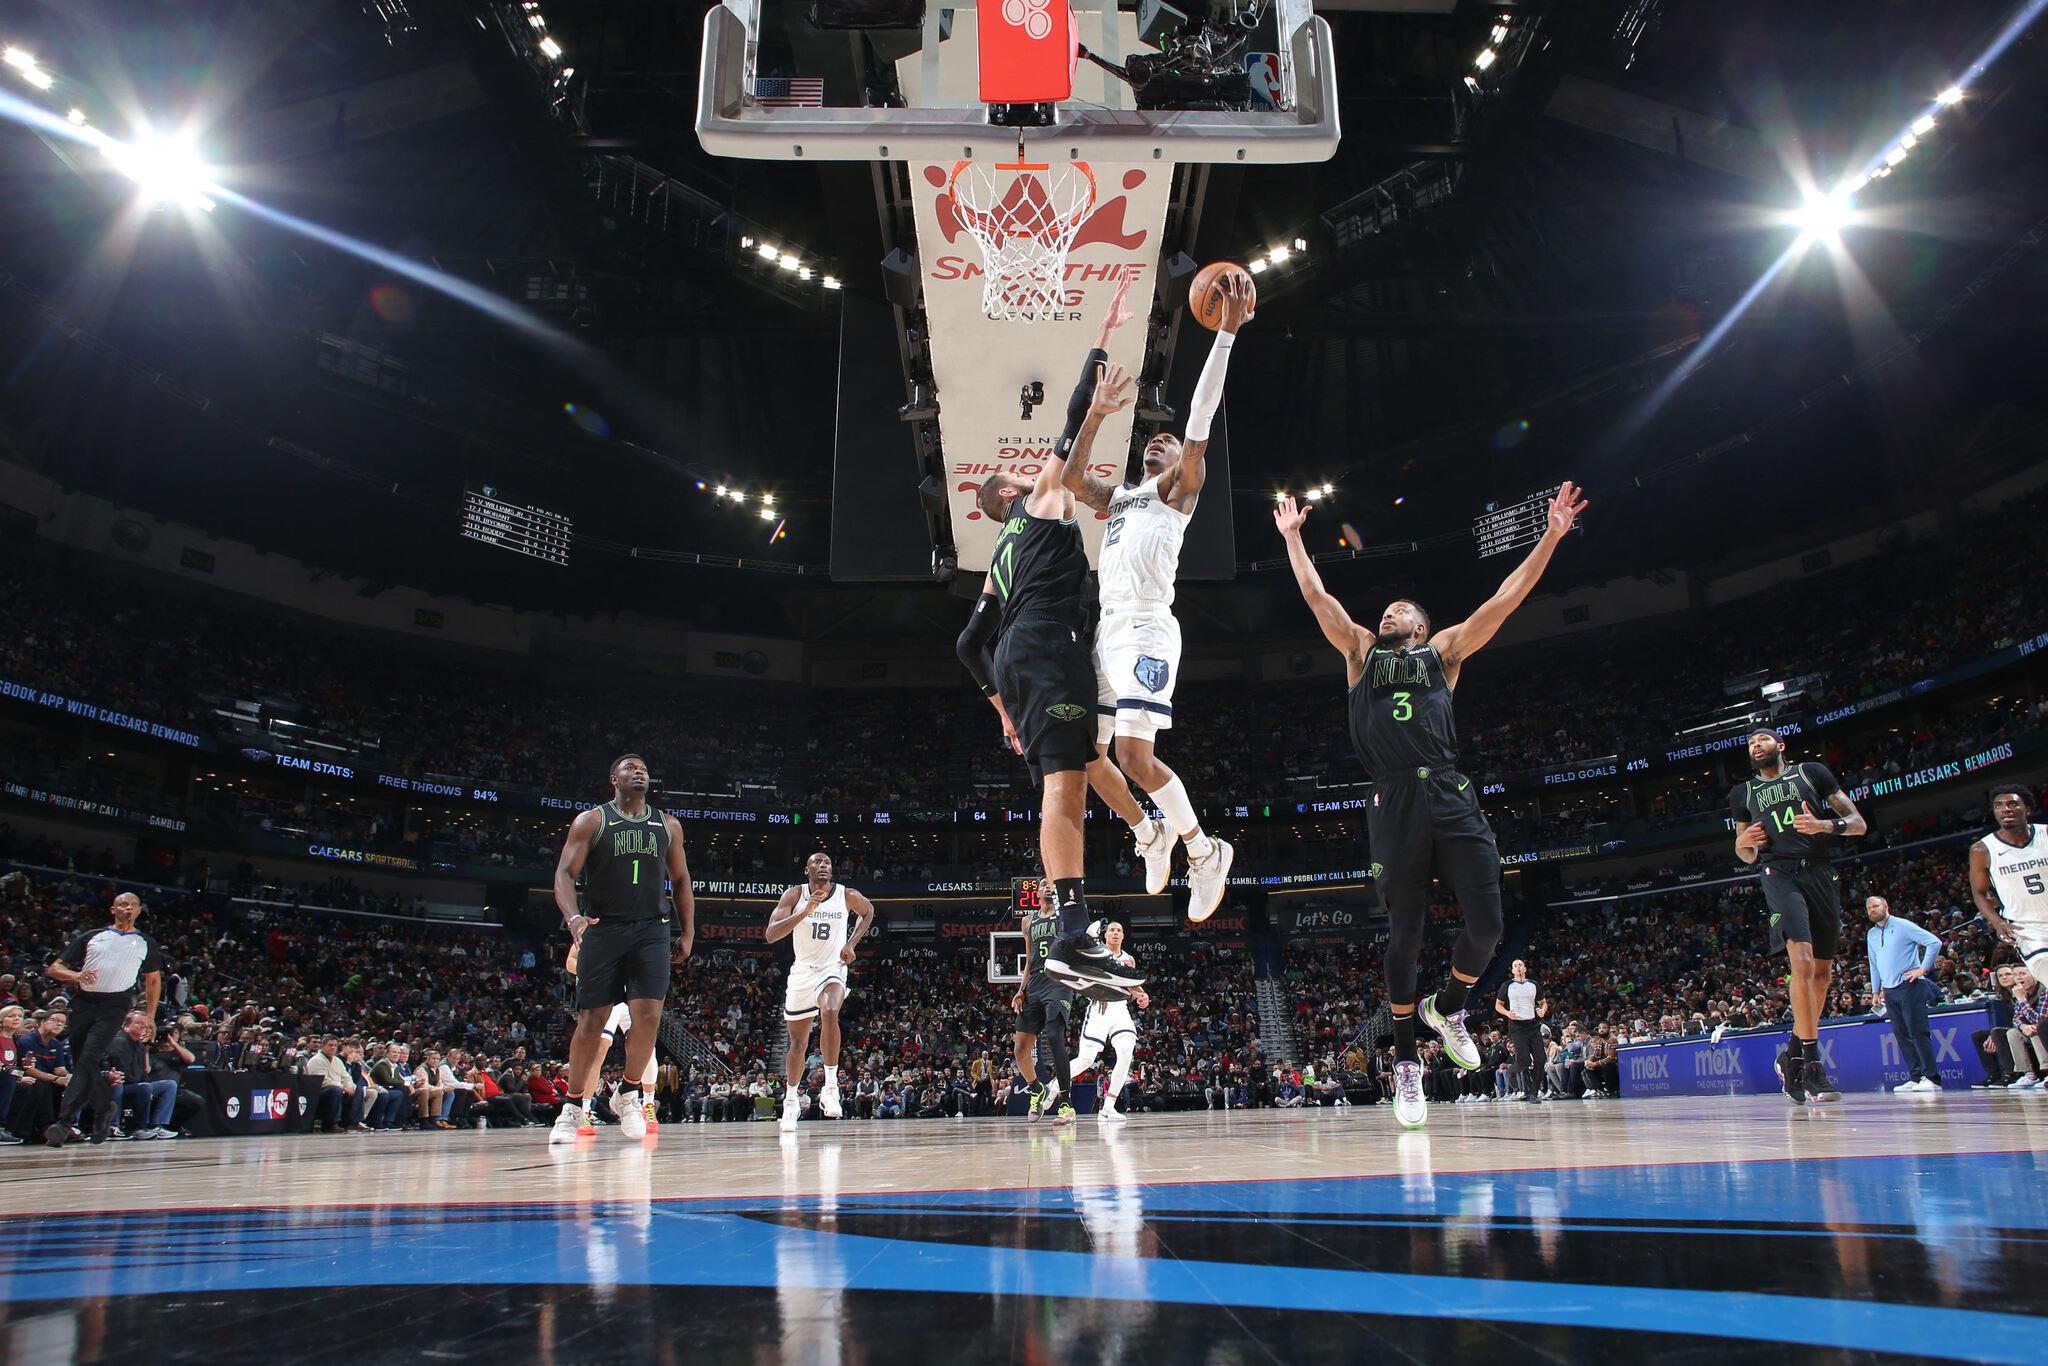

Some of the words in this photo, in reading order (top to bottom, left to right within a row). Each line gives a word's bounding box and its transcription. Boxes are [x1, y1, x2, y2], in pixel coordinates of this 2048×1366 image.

[930, 256, 1147, 282] SMTHIE
[1108, 497, 1150, 518] EMPHIS
[1104, 518, 1125, 549] 12
[2018, 642, 2036, 657] THE
[1373, 657, 1430, 688] NOLA
[1392, 692, 1413, 721] 3
[1816, 705, 1856, 725] CAESARS
[39, 692, 66, 709] APP
[66, 699, 96, 719] WITH
[99, 708, 150, 734] CAESARS
[150, 723, 200, 748] REWARDS
[1666, 746, 1702, 762] THREE
[1705, 734, 1750, 753] POINTE
[275, 753, 311, 772] TEAM
[314, 762, 355, 780] STATS:
[1849, 786, 1870, 802] APP
[1872, 776, 1902, 797] WITH
[1906, 762, 1961, 788] CAESARS
[1964, 742, 2013, 772] REWARDS
[1483, 782, 1505, 796] 64%
[1544, 772, 1576, 784] FIELD
[1578, 765, 1617, 780] GOALS
[1626, 758, 1649, 772] 41%
[378, 774, 408, 790] FREE
[412, 781, 462, 798] THROWS
[473, 788, 498, 802] 94%
[1756, 782, 1802, 812] NOLA
[540, 797, 572, 809] FIELD
[574, 802, 598, 811] GOA
[666, 808, 701, 820] THREE
[703, 810, 756, 822] POINTERS
[768, 814, 790, 825] 50%
[974, 811, 986, 821] 64
[1312, 802, 1340, 812] TEAM
[1342, 800, 1367, 810] STAT
[832, 814, 840, 824] 3
[1771, 806, 1795, 833] 14
[308, 844, 363, 862] CAESARS
[614, 830, 659, 857] NOLA
[1500, 852, 1538, 866] AESARS
[1999, 858, 2048, 876] MEMPHI
[632, 860, 640, 885] 1
[1294, 873, 1328, 882] PROBLEM?
[1329, 872, 1345, 881] CALL
[692, 880, 706, 892] PP
[708, 881, 736, 894] WITH
[738, 882, 784, 895] CAESARS
[928, 883, 973, 892] CAESARS
[1023, 880, 1037, 890] 8:5
[2023, 874, 2044, 894] 5
[1184, 917, 1247, 930] SEATGEEK
[1296, 912, 1329, 927] Let's
[1332, 910, 1353, 925] Go
[700, 924, 768, 939] SEATGEE
[811, 922, 831, 940] 18
[1031, 921, 1057, 941] NOLA
[1375, 933, 1391, 942] Let
[1039, 941, 1049, 958] 5
[1154, 942, 1167, 951] Go
[1630, 1054, 1670, 1080] max
[1694, 1047, 1743, 1076] max
[1884, 1072, 1898, 1081] THE
[1900, 1072, 1911, 1081] ON
[1939, 1069, 1964, 1079] ATCH
